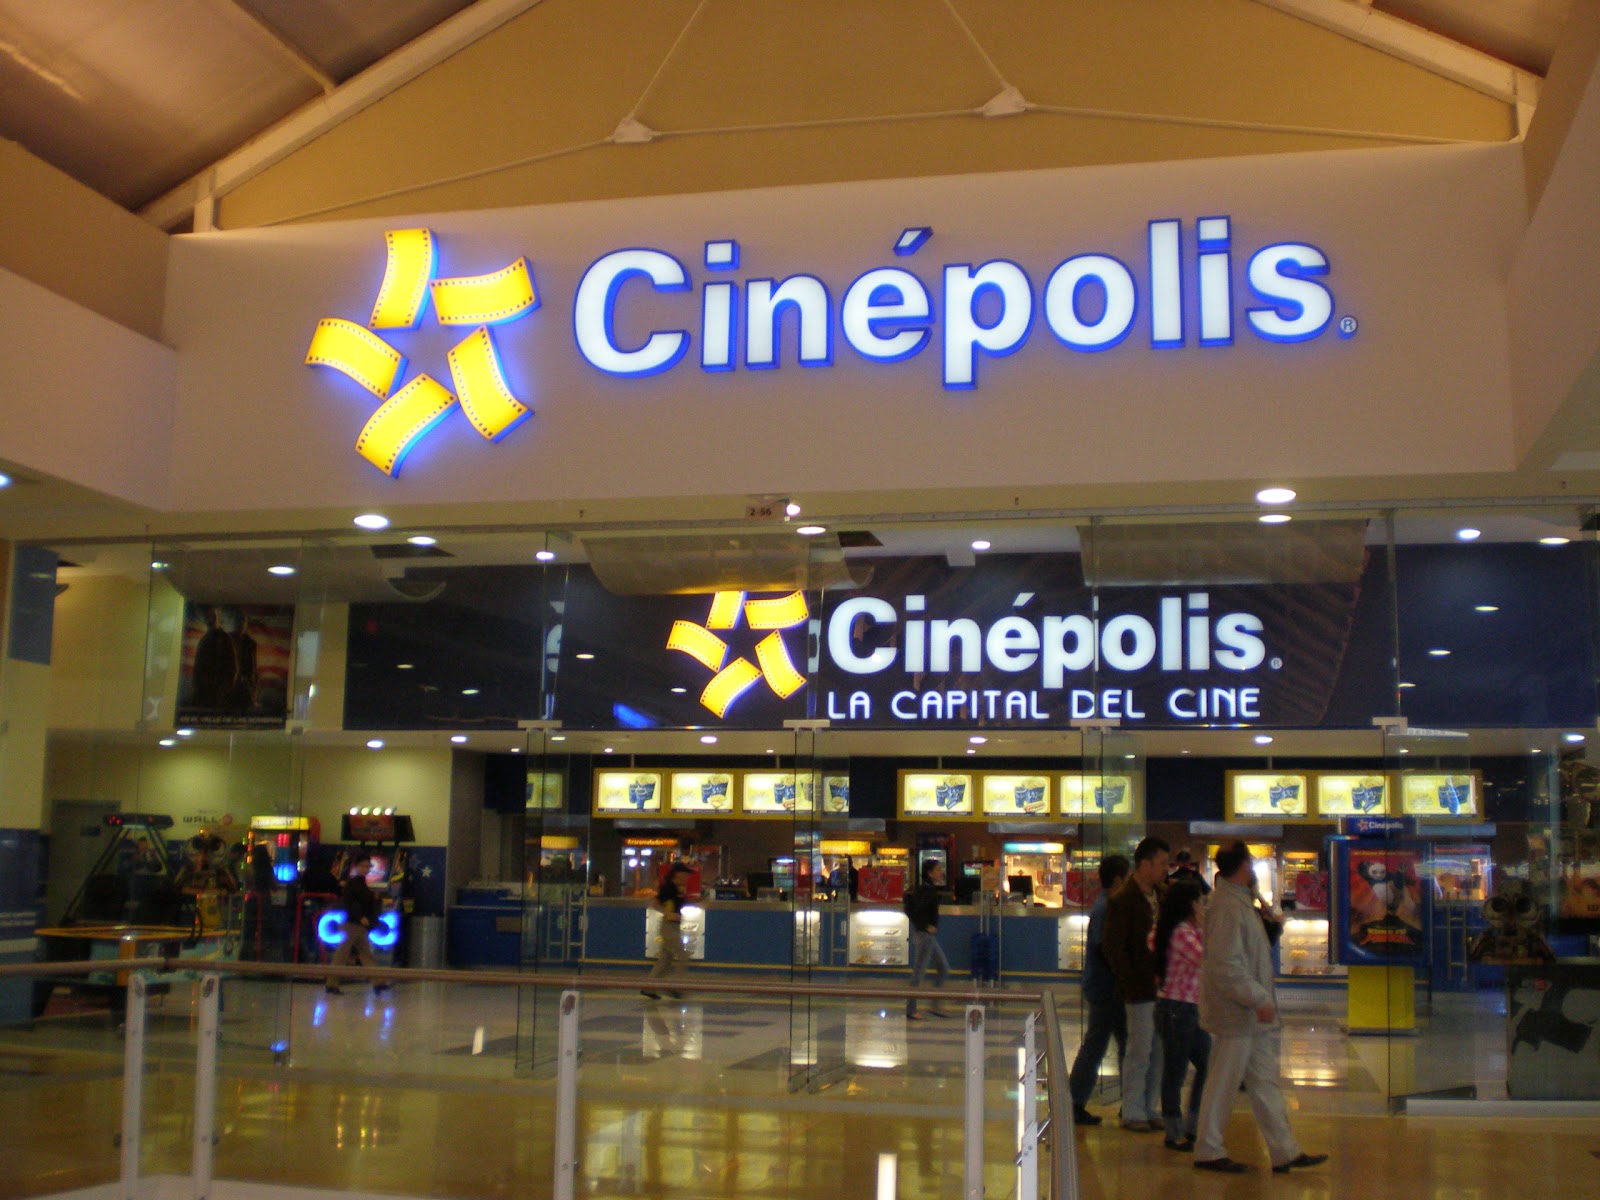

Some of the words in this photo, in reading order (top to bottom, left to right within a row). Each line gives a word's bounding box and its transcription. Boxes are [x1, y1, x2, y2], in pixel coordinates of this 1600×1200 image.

[574, 216, 1335, 389] Cinépolis
[828, 592, 1266, 689] Cinépolis
[827, 691, 871, 720] LA
[891, 690, 1050, 720] CAPITAL
[1070, 689, 1146, 720] DEL
[1168, 687, 1261, 719] CINE
